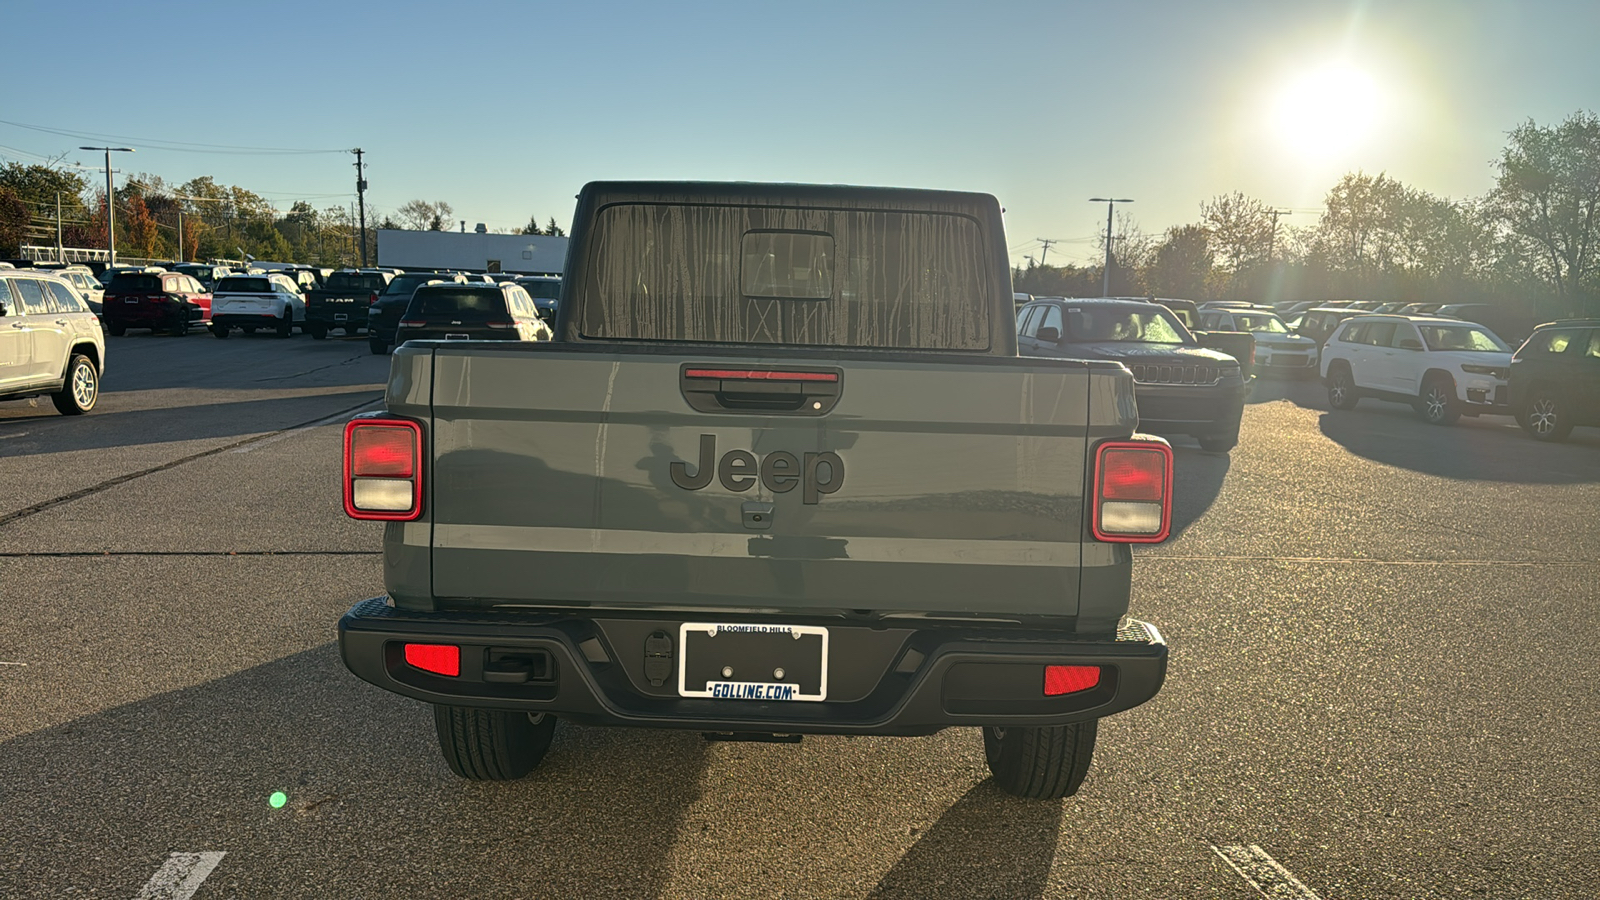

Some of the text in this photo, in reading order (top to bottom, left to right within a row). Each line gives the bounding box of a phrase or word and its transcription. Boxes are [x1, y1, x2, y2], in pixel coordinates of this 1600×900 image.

[670, 434, 845, 505] Jeep
[717, 625, 792, 634] BLOOMFIELD HILLS
[713, 683, 792, 700] GOLLING.COM
